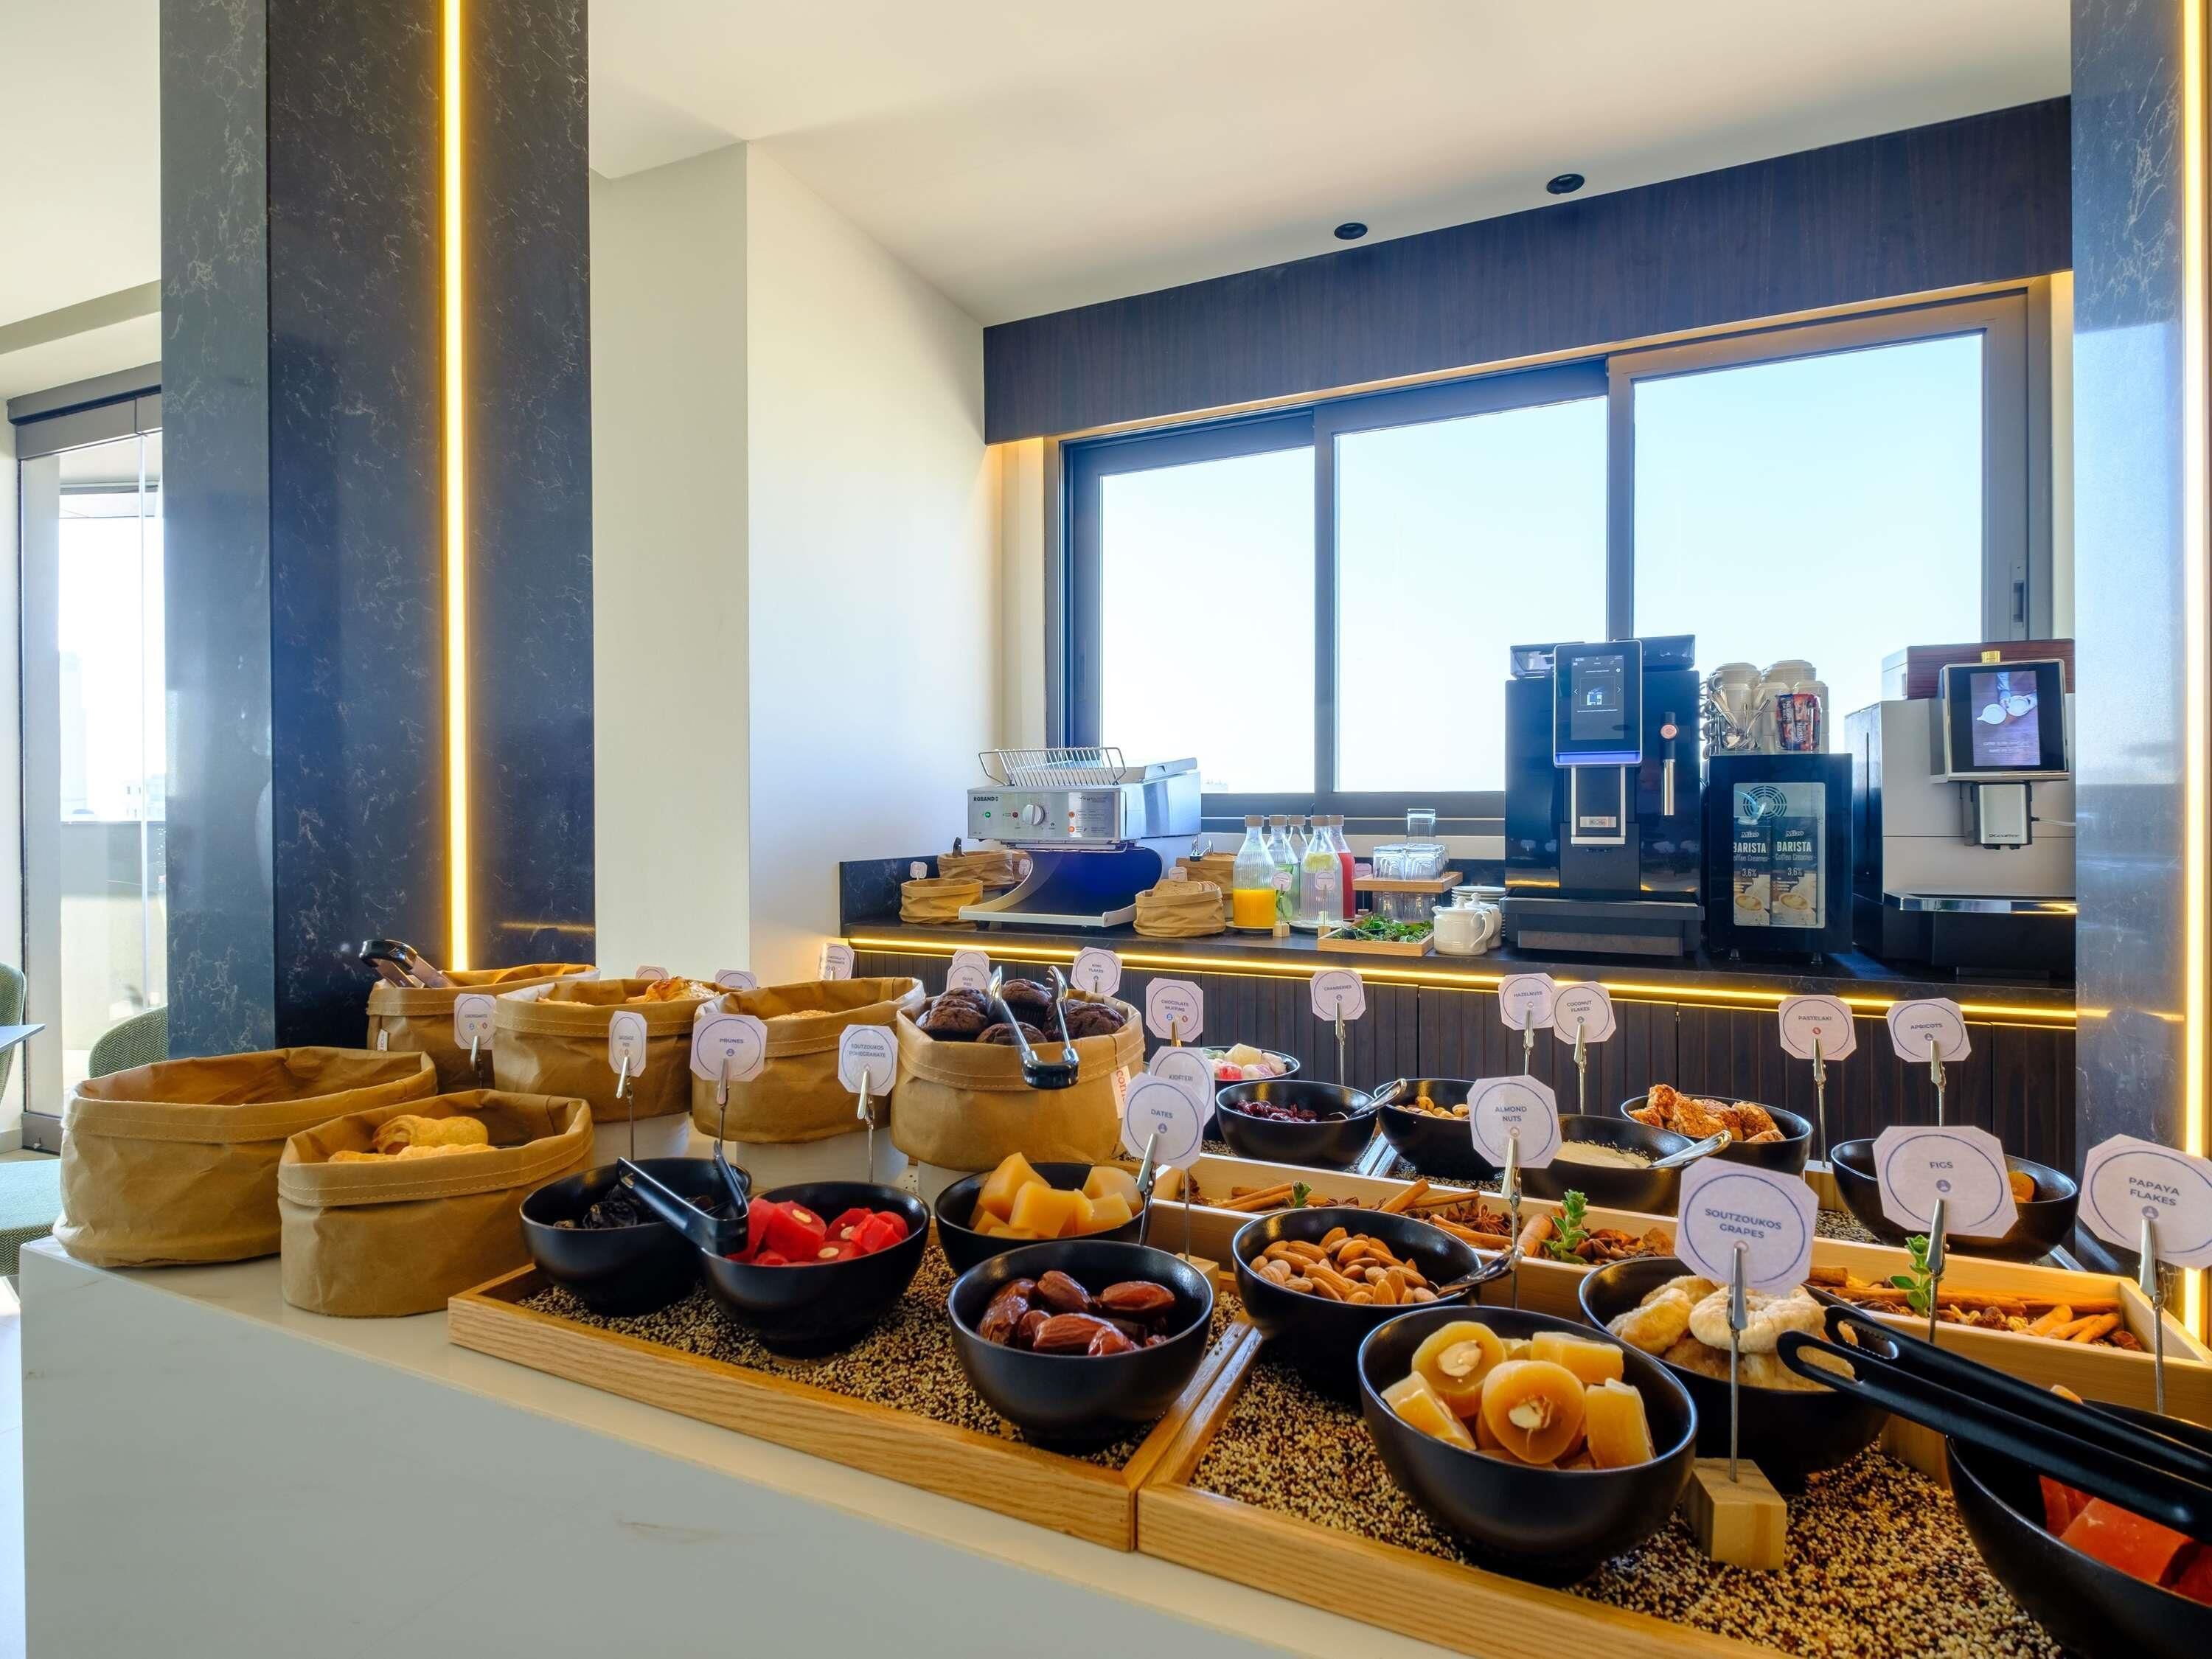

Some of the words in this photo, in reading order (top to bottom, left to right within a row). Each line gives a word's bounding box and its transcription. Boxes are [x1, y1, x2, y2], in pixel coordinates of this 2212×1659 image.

[1777, 841, 1812, 852] BARISTA
[1161, 999, 1189, 1007] CHOCOLATE
[1150, 1109, 1173, 1119] DATES
[2129, 1177, 2180, 1196] PAPAYA
[2129, 1189, 2177, 1206] FLAKES
[1705, 1208, 1782, 1230] SOUTZOUKOS
[1719, 1222, 1764, 1239] GRAPES
